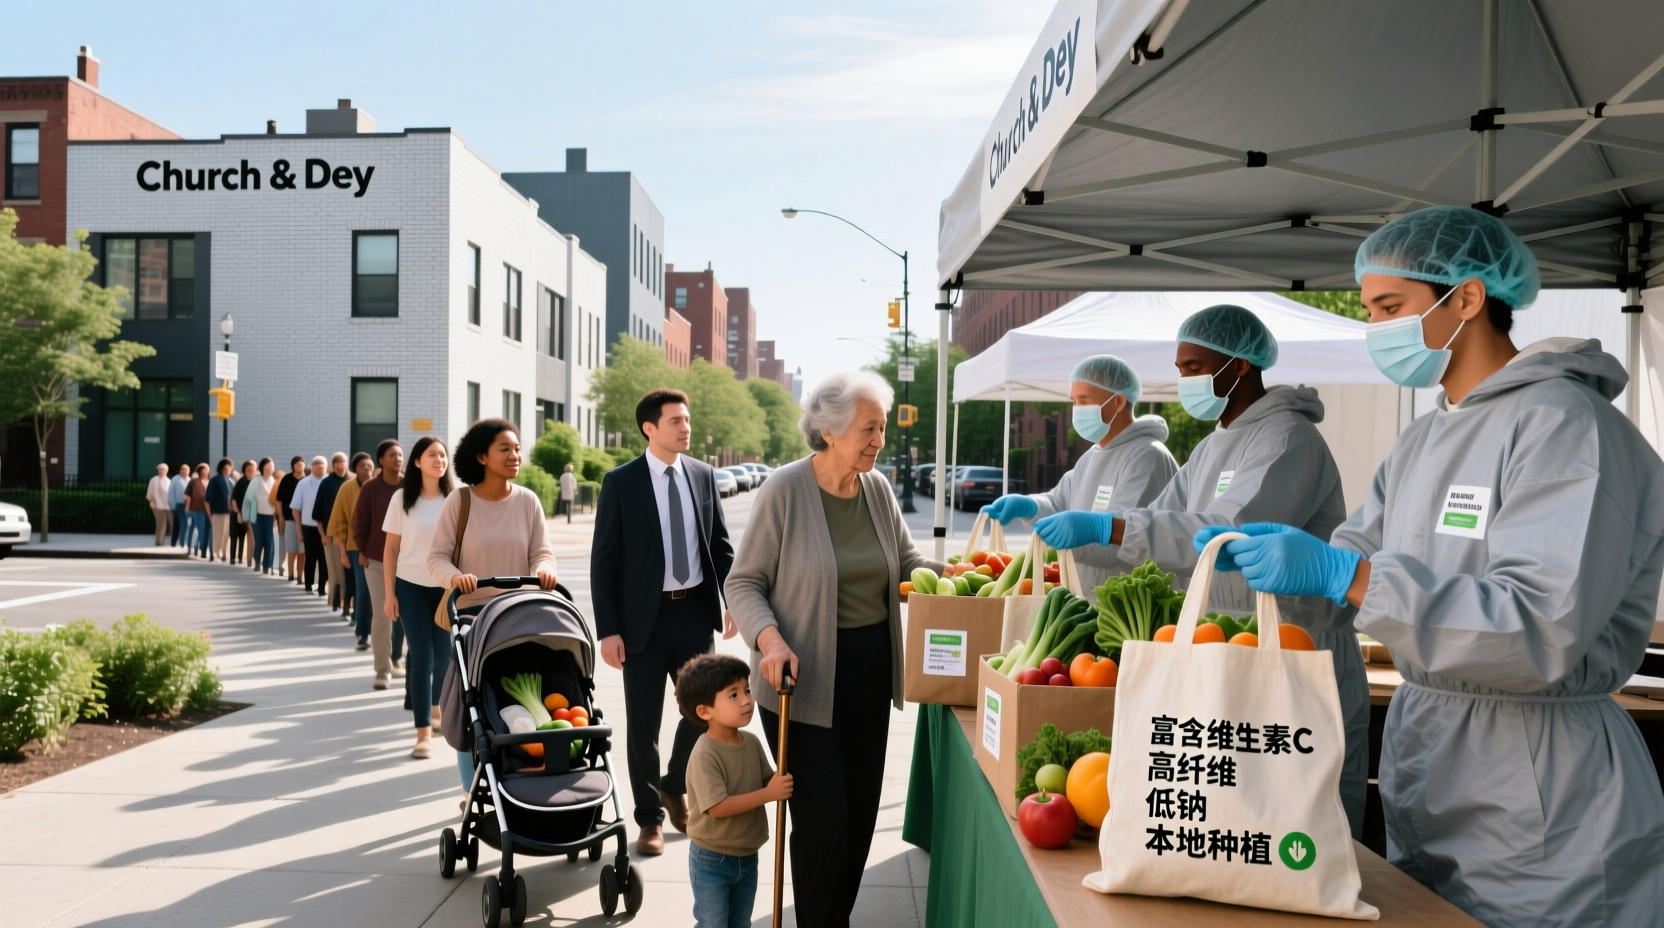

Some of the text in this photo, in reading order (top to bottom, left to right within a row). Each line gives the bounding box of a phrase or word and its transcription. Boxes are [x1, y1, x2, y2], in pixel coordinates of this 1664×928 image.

[989, 16, 1081, 189] Church & Dey
[136, 158, 376, 198] Church & Dey
[1150, 714, 1314, 755] 富含维生素C
[1148, 750, 1237, 787] 高纤维
[1145, 787, 1207, 822] 低钠
[1145, 823, 1273, 866] 本地种植
